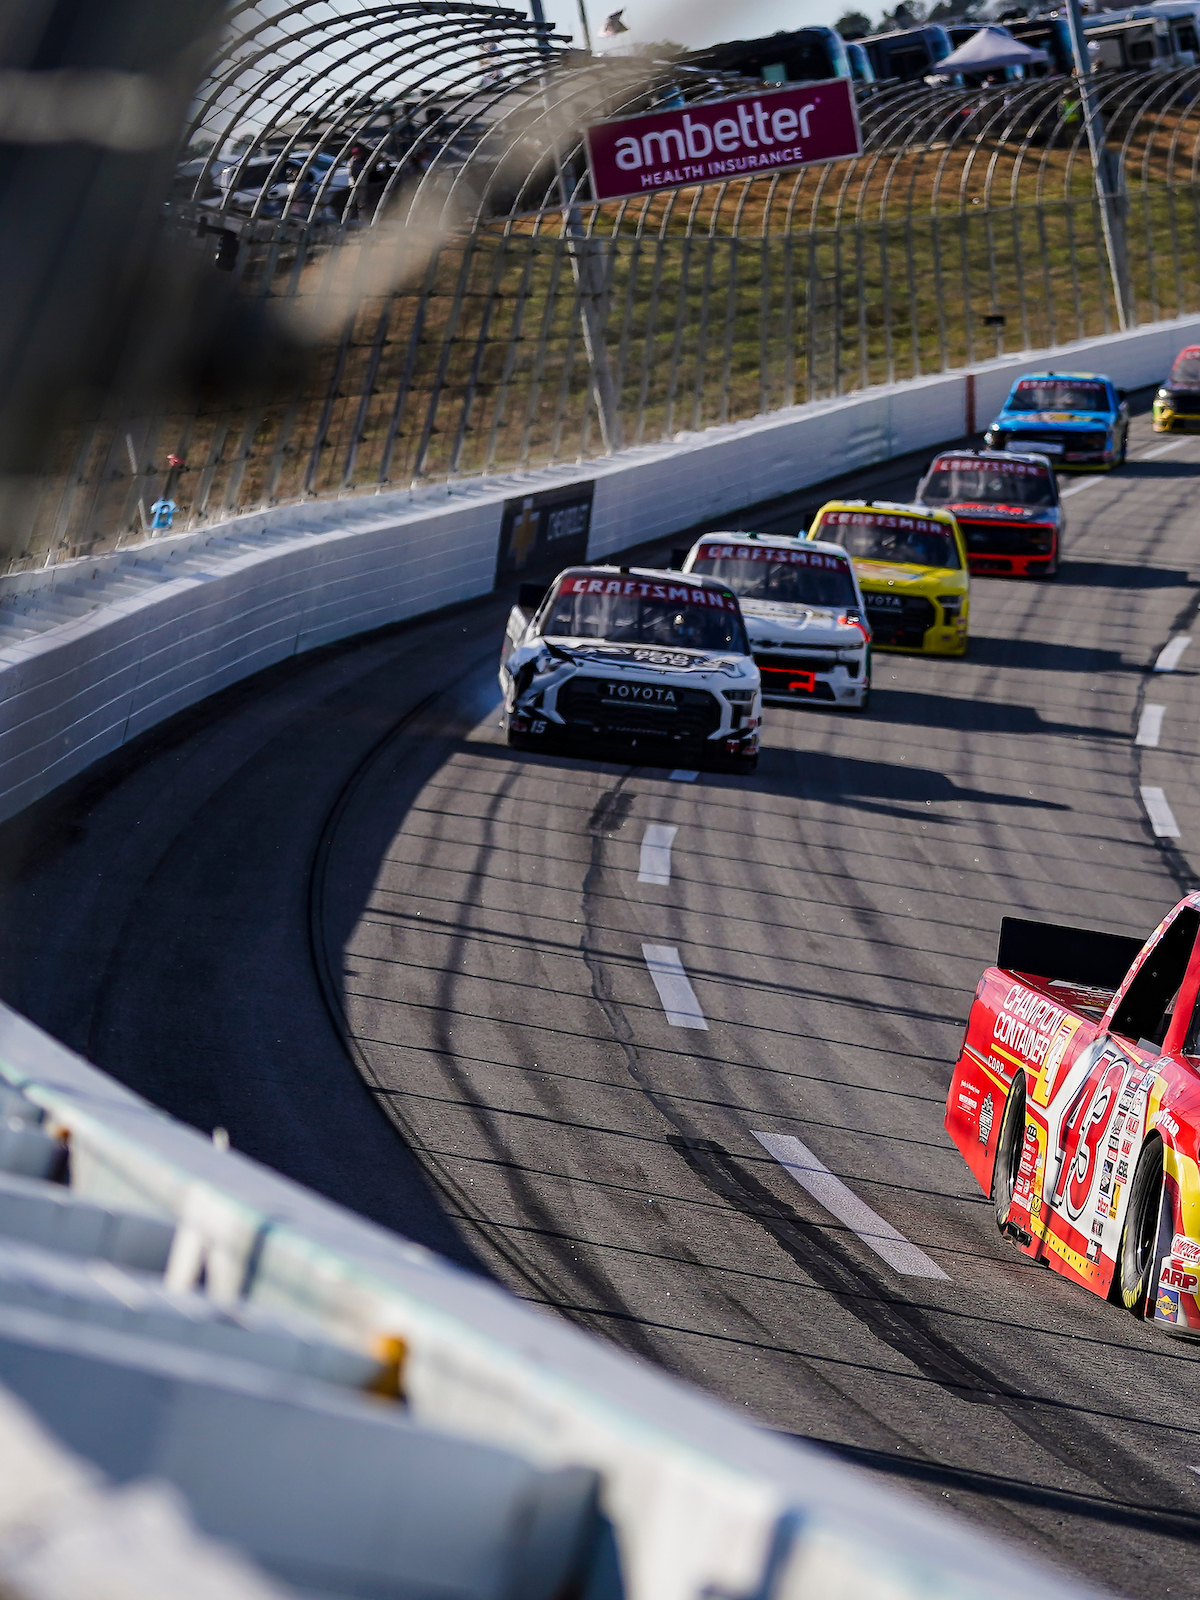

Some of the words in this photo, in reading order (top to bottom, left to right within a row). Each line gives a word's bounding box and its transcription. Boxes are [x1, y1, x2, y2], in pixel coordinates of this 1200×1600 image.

[614, 101, 816, 171] ambetter
[641, 164, 704, 187] HEALTH
[708, 147, 804, 176] INSURANCE
[940, 460, 1038, 475] CRAFTSMAN
[826, 512, 942, 534] CRAFTSMAN
[707, 545, 838, 569] CRAFTSMAN
[572, 579, 724, 607] CRAFTSMAN
[867, 596, 901, 606] YOTA
[607, 684, 676, 702] TOYOTA
[530, 721, 547, 734] 15
[1003, 985, 1067, 1036] CHAMPION
[993, 1011, 1050, 1066] CONTAINER
[1051, 1049, 1129, 1221] 43
[1161, 1268, 1198, 1290] ARP
[1156, 1297, 1178, 1312] SUNOCO
